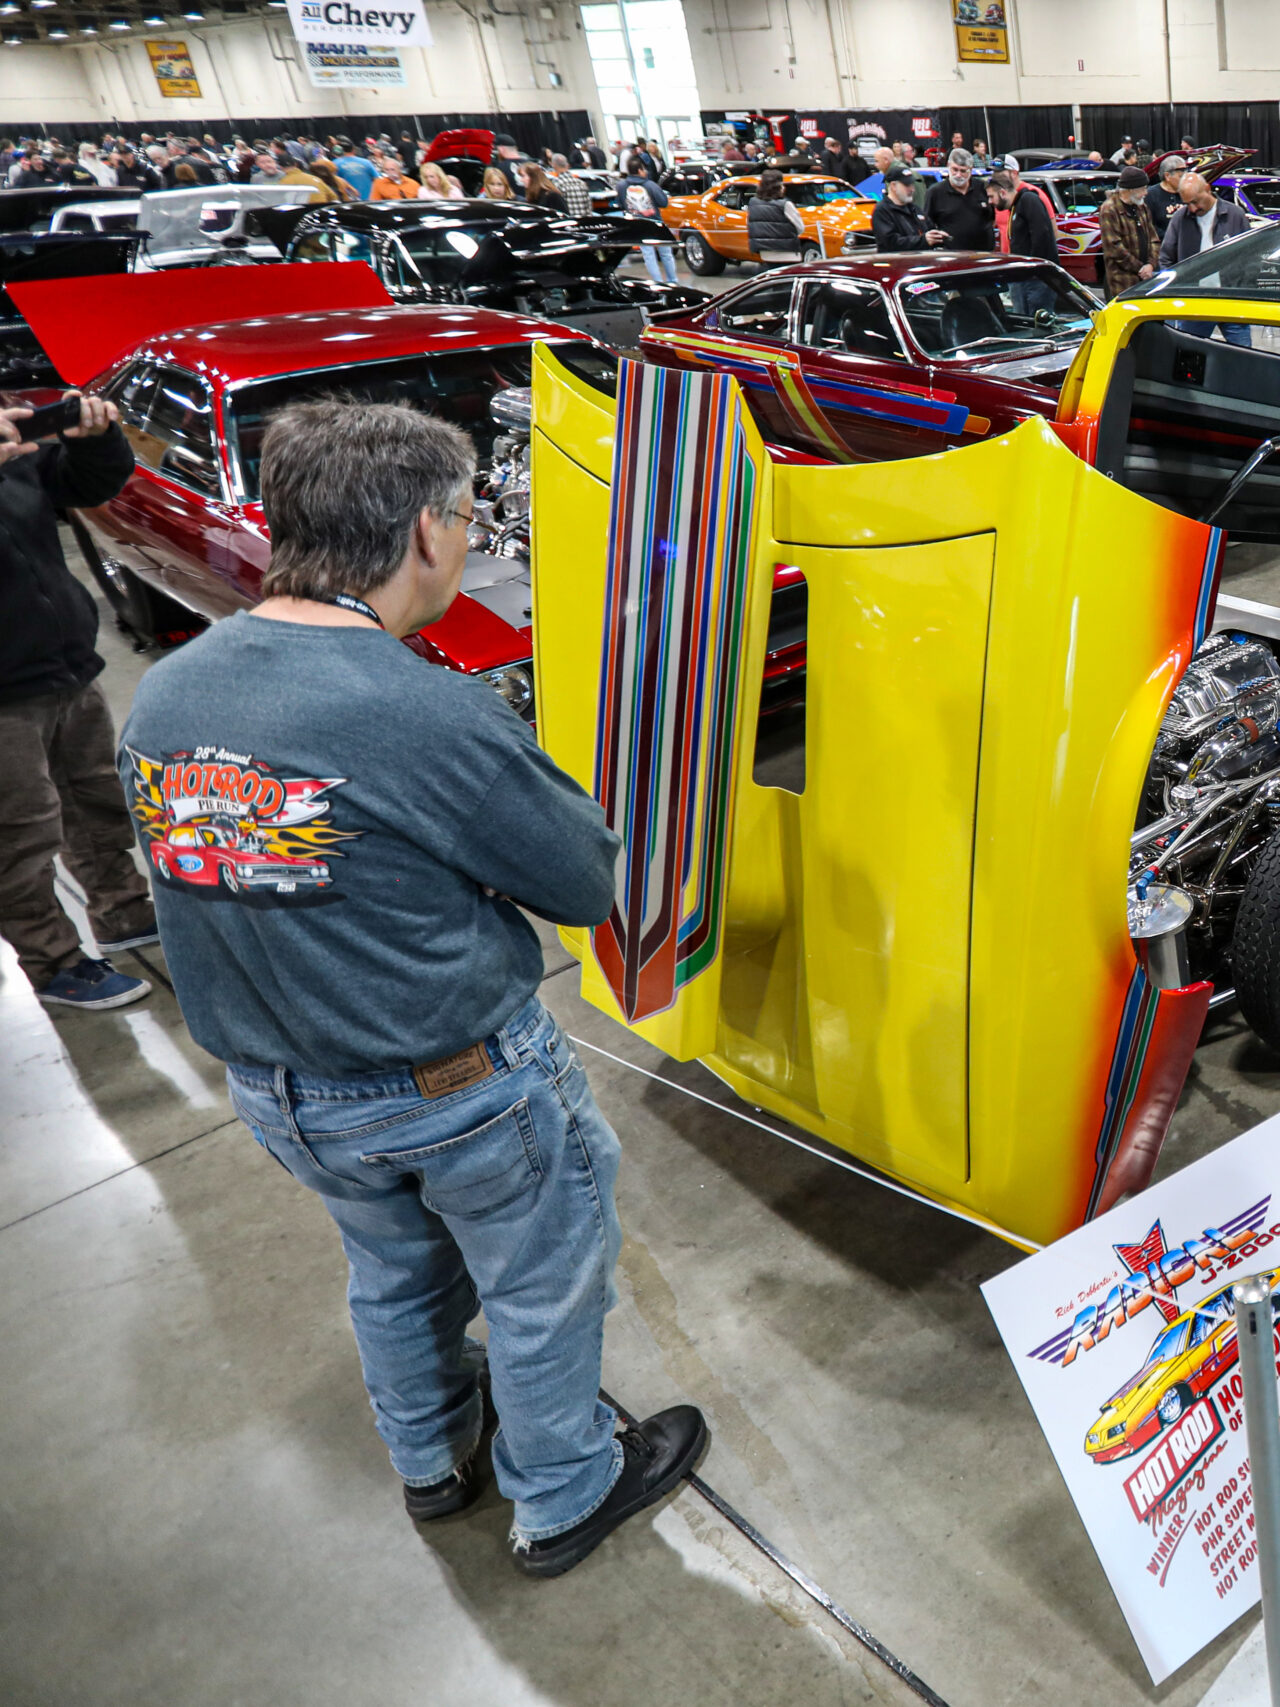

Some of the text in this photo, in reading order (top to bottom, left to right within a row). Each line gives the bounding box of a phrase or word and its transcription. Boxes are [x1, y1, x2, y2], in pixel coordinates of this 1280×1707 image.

[324, 1, 416, 35] Chevy
[343, 70, 403, 79] PERFORMANCE
[215, 748, 253, 765] Annual
[162, 763, 286, 818] HOT ROD
[197, 799, 240, 812] PIE RUN
[1054, 1300, 1074, 1318] Rick
[1062, 1227, 1258, 1368] RADICAL
[1216, 1366, 1243, 1414] HO
[1227, 1408, 1242, 1431] OF
[1128, 1400, 1215, 1514] HOT ROD
[1148, 1439, 1228, 1538] Magazine
[1193, 1503, 1215, 1536] HOT
[1214, 1477, 1237, 1508] ROD
[1145, 1513, 1184, 1575] WINNER
[1201, 1524, 1224, 1557] PHR
[1209, 1525, 1245, 1577] STREET
[1215, 1566, 1237, 1599] HOT
